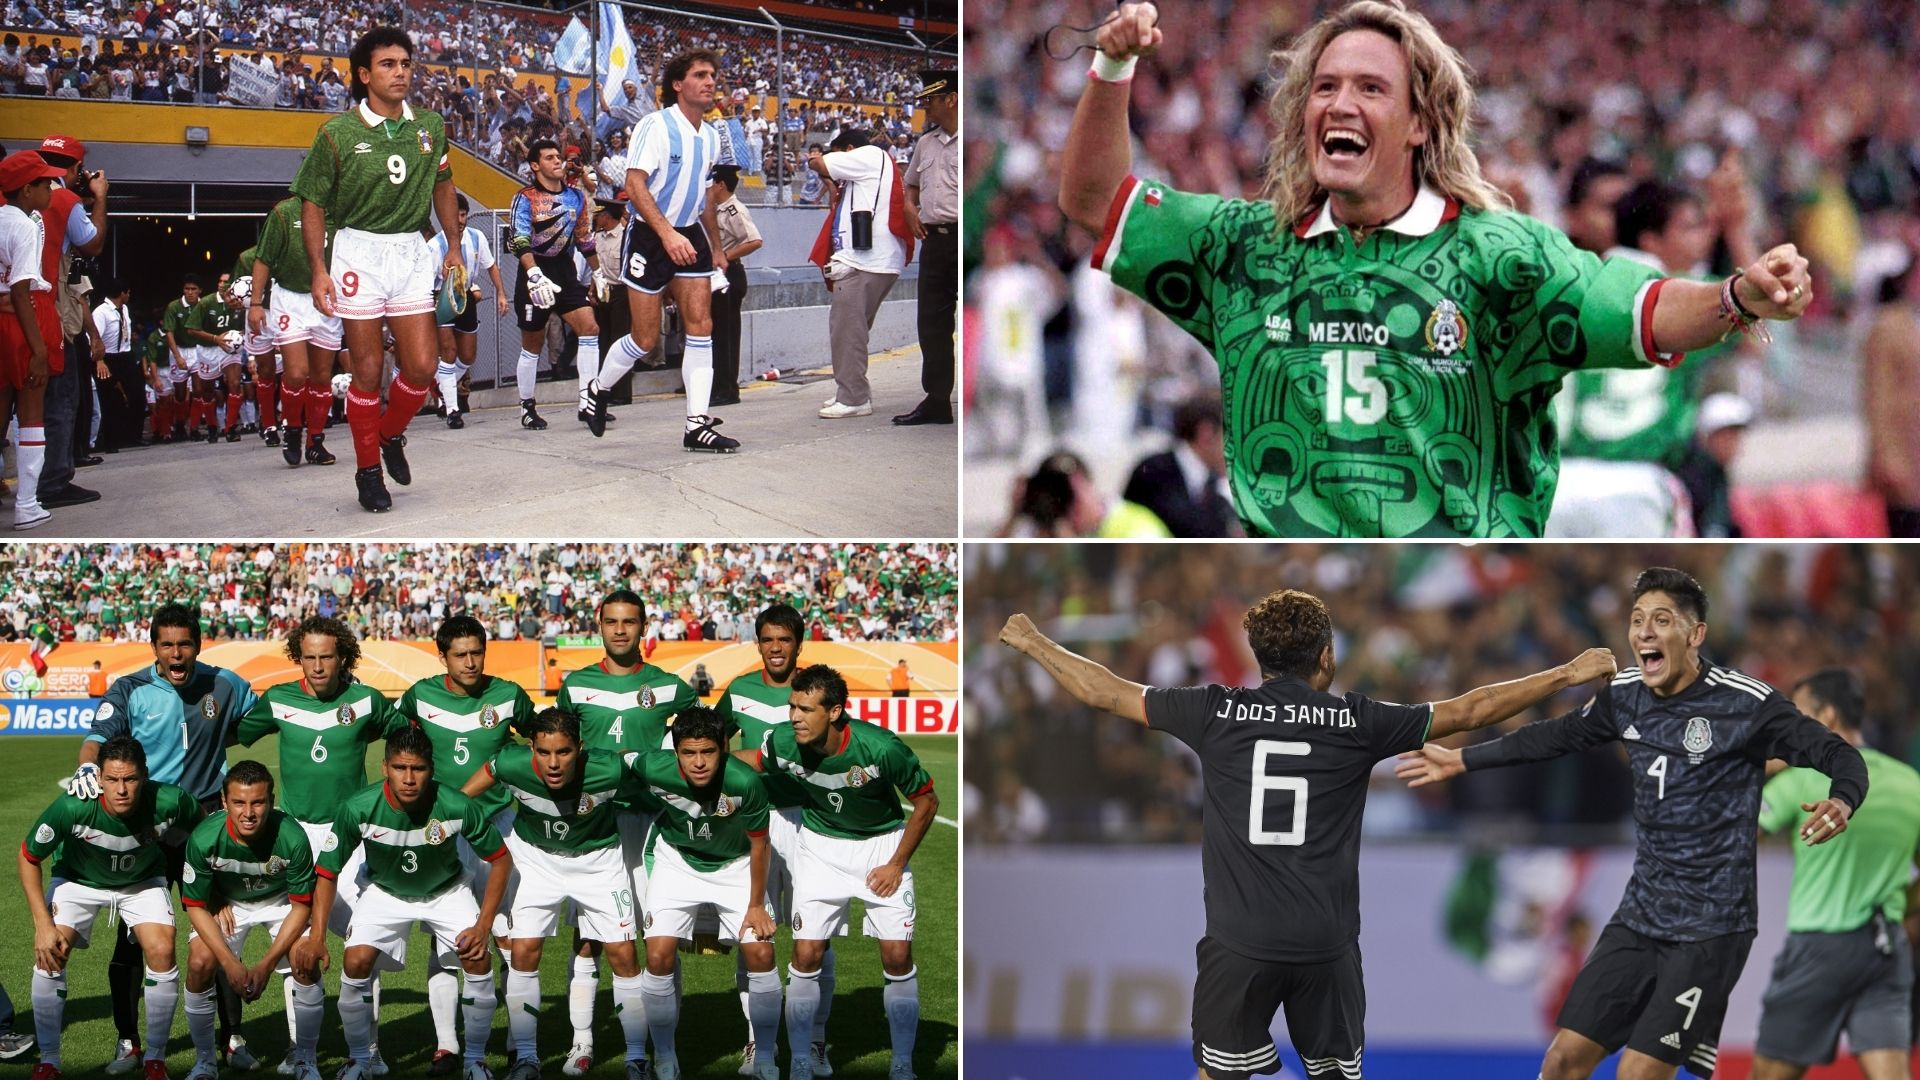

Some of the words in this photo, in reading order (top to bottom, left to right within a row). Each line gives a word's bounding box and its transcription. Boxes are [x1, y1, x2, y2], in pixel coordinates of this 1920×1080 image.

[387, 154, 407, 185] 9
[341, 271, 359, 298] 9
[216, 314, 230, 328] 21
[278, 314, 290, 331] 8
[1265, 314, 1292, 331] ABA
[1309, 321, 1389, 345] MEXICO
[1321, 349, 1388, 425] 15
[1235, 703, 1276, 723] DOS
[181, 722, 188, 750] 1
[607, 715, 624, 744] 4
[310, 736, 328, 763] 6
[453, 738, 470, 765] 5
[1647, 755, 1668, 800] 4
[827, 792, 844, 814] 9
[1249, 739, 1312, 847] 6
[543, 820, 570, 841] 19
[686, 820, 713, 841] 14
[110, 854, 136, 873] 10
[401, 850, 418, 874] 3
[611, 889, 633, 919] 19
[1675, 986, 1703, 1031] 4
